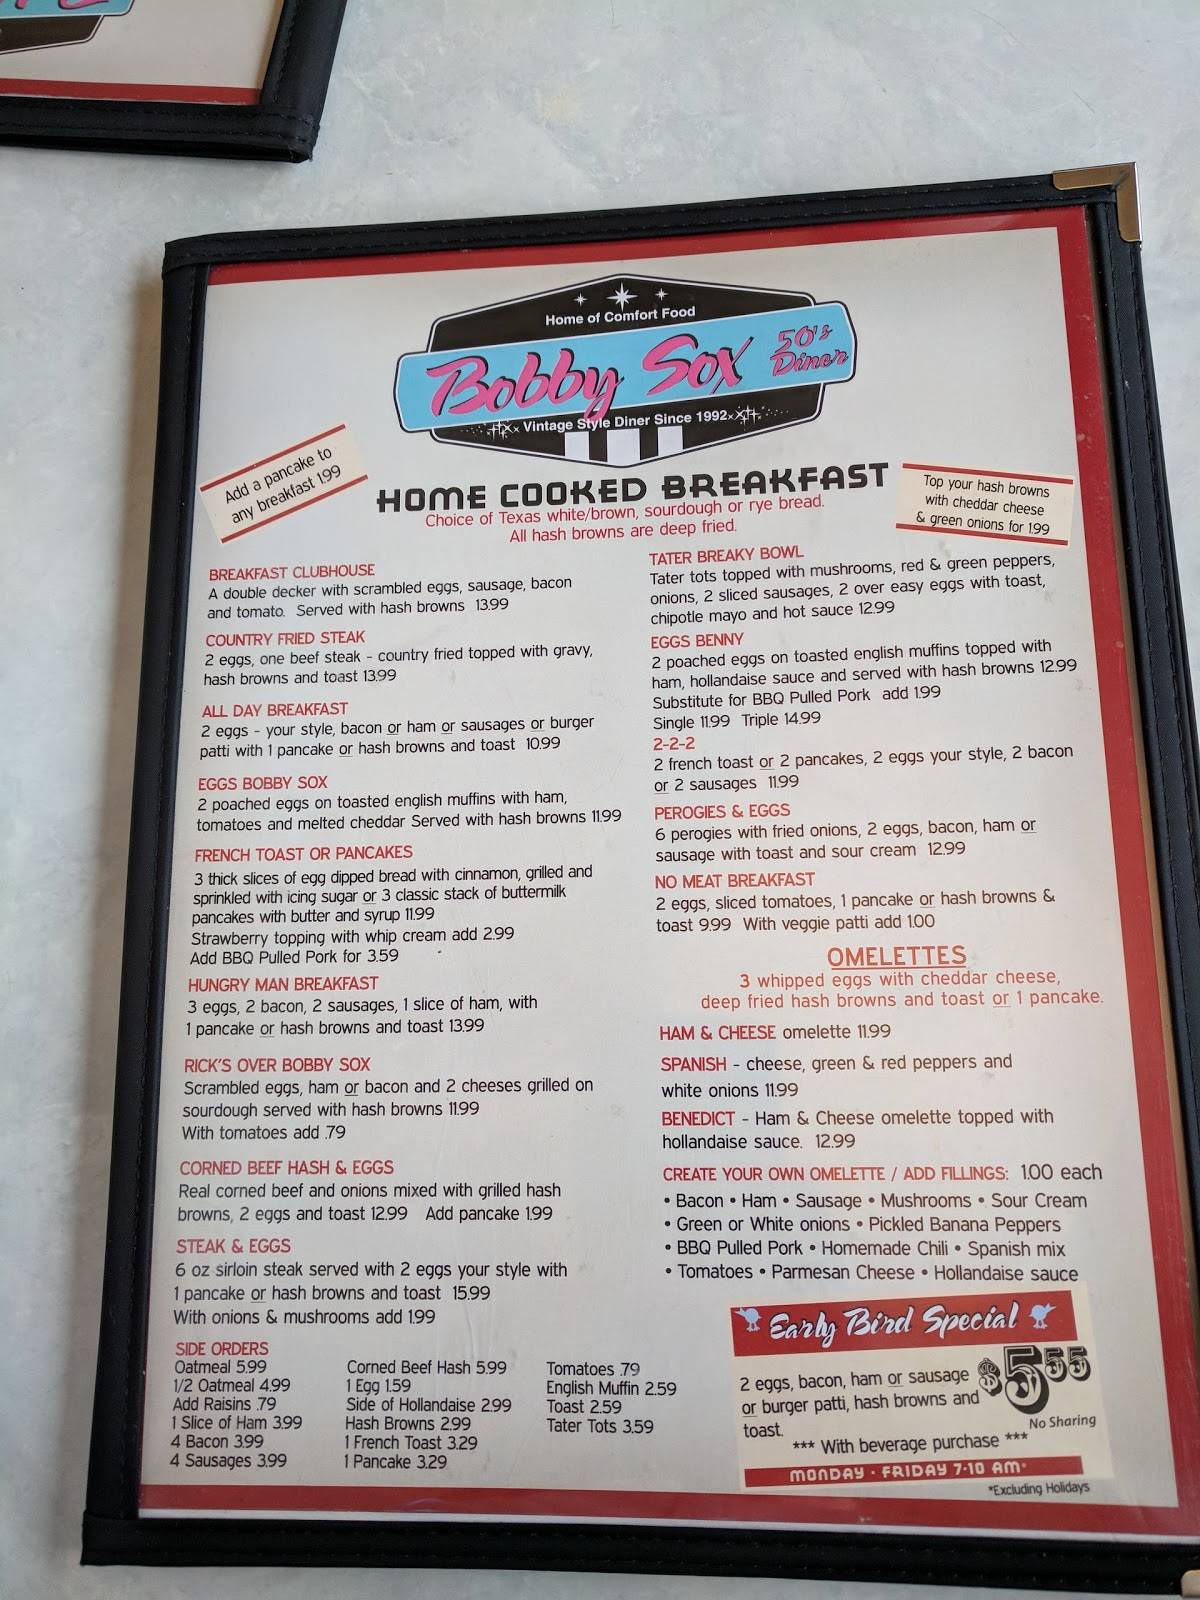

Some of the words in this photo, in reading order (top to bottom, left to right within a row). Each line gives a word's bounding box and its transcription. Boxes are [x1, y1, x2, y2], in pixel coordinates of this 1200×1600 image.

[546, 314, 584, 326] Home
[587, 312, 600, 324] of
[604, 309, 658, 322] Comfort
[662, 306, 695, 319] Food
[773, 324, 833, 354] 50's
[770, 349, 849, 377] Diner
[426, 348, 625, 421] Bobby
[642, 333, 755, 396] Sox
[523, 420, 573, 433] Vintage
[577, 418, 611, 431] Style
[615, 416, 651, 427] Diner
[654, 413, 692, 425] Since
[696, 410, 728, 423] 1992
[226, 482, 250, 504] Add
[264, 455, 315, 488] pancake
[317, 448, 332, 461] to
[231, 506, 254, 524] any
[257, 476, 316, 513] breakfast
[316, 465, 341, 485] 1.99
[377, 485, 486, 513] HOME
[500, 477, 647, 508] COOKED
[661, 462, 889, 500] BREAKFAST
[923, 474, 944, 490] Top
[948, 479, 973, 491] your
[977, 479, 1004, 493] hash
[1008, 482, 1050, 498] browns
[425, 513, 474, 527] Choice
[479, 511, 493, 525] of
[498, 511, 541, 524] Texas
[644, 500, 722, 517] sourdough
[728, 501, 744, 513] or
[749, 499, 773, 514] rye
[925, 493, 949, 506] with
[952, 496, 999, 511] cheddar
[1003, 501, 1045, 516] cheese
[509, 529, 527, 543] All
[532, 527, 566, 542] hash
[572, 526, 625, 540] browns
[630, 525, 654, 538] are
[660, 522, 696, 537] deep
[930, 513, 963, 527] green
[967, 517, 1004, 531] onions
[1009, 519, 1025, 534] for
[649, 551, 692, 566] TATER
[697, 547, 755, 563] BREAKY
[760, 545, 805, 560] BOWL
[209, 567, 288, 581] BREAKFAST
[292, 563, 375, 579] CLUBHOUSE
[207, 606, 232, 619] and
[296, 603, 343, 617] Served
[348, 602, 376, 615] with
[380, 601, 412, 614] hash
[417, 600, 465, 613] browns
[475, 597, 509, 611] 13.99
[205, 633, 273, 647] COUNTRY
[278, 632, 315, 645] FRIED
[320, 630, 365, 644] STEAK
[651, 635, 691, 649] EGGS
[696, 632, 744, 647] BENNY
[202, 705, 228, 718] ALL
[233, 704, 262, 717] DAY
[267, 702, 349, 716] BREAKFAST
[653, 736, 695, 751] 2-2-2
[198, 777, 238, 791] EGGS
[243, 776, 292, 790] BOBBY
[297, 775, 328, 789] SOX
[655, 805, 727, 820] PEROGIES
[749, 803, 791, 818] EGGS
[195, 848, 250, 862] FRENCH
[255, 847, 305, 861] TOAST
[309, 847, 330, 861] OR
[336, 845, 413, 860] PANCAKES
[655, 875, 677, 889] NO
[682, 874, 723, 889] MEAT
[728, 872, 815, 888] BREAKFAST
[827, 945, 967, 971] OMELETTES
[188, 978, 250, 992] HUNGRY
[255, 977, 289, 992] MAN
[294, 976, 379, 991] BREAKFAST
[660, 1025, 695, 1041] HAM
[718, 1025, 777, 1040] CHEESE
[783, 1024, 851, 1039] omelette
[857, 1024, 891, 1038] 11.99
[184, 1058, 232, 1073] RICK'S
[237, 1058, 277, 1072] OVER
[282, 1057, 334, 1072] BOBBY
[339, 1057, 371, 1072] SOX
[180, 1160, 242, 1176] CORNED
[247, 1160, 283, 1175] BEEF
[288, 1160, 330, 1175] HASH
[352, 1160, 394, 1175] EGGS
[663, 1167, 717, 1181] CREATE
[722, 1167, 763, 1181] YOUR
[768, 1167, 805, 1181] OWN
[810, 1167, 886, 1181] OMELETTE
[904, 1166, 936, 1180] ADD
[1021, 1163, 1053, 1180] 1.00
[1060, 1163, 1103, 1180] each
[176, 1238, 226, 1254] STEAK
[249, 1238, 291, 1254] EGGS
[769, 1311, 836, 1348] Early
[843, 1305, 914, 1336] Bird
[922, 1301, 1019, 1339] Special
[175, 1342, 206, 1356] SIDE
[211, 1341, 269, 1356] ORDERS
[850, 1371, 883, 1386] ham
[888, 1372, 903, 1388] or
[908, 1369, 970, 1385] sausage
[741, 1402, 757, 1418] or
[762, 1399, 809, 1416] burger
[854, 1393, 889, 1410] hash
[894, 1393, 947, 1408] browns
[953, 1389, 980, 1405] and
[181, 1415, 213, 1430] Slice
[218, 1415, 232, 1430] of
[236, 1415, 267, 1430] Ham
[272, 1415, 303, 1430] 3.99
[546, 1418, 583, 1433] Tater
[587, 1418, 617, 1434] Tots
[622, 1419, 654, 1434] 3.59
[1029, 1418, 1046, 1430] No
[1049, 1414, 1096, 1428] Sharing
[820, 1438, 854, 1455] With
[859, 1437, 927, 1454] beverage
[932, 1433, 999, 1453] purchase
[790, 1467, 864, 1482] MONDAY
[882, 1463, 947, 1478] FRIDAY
[1045, 1481, 1091, 1495] Holidays
